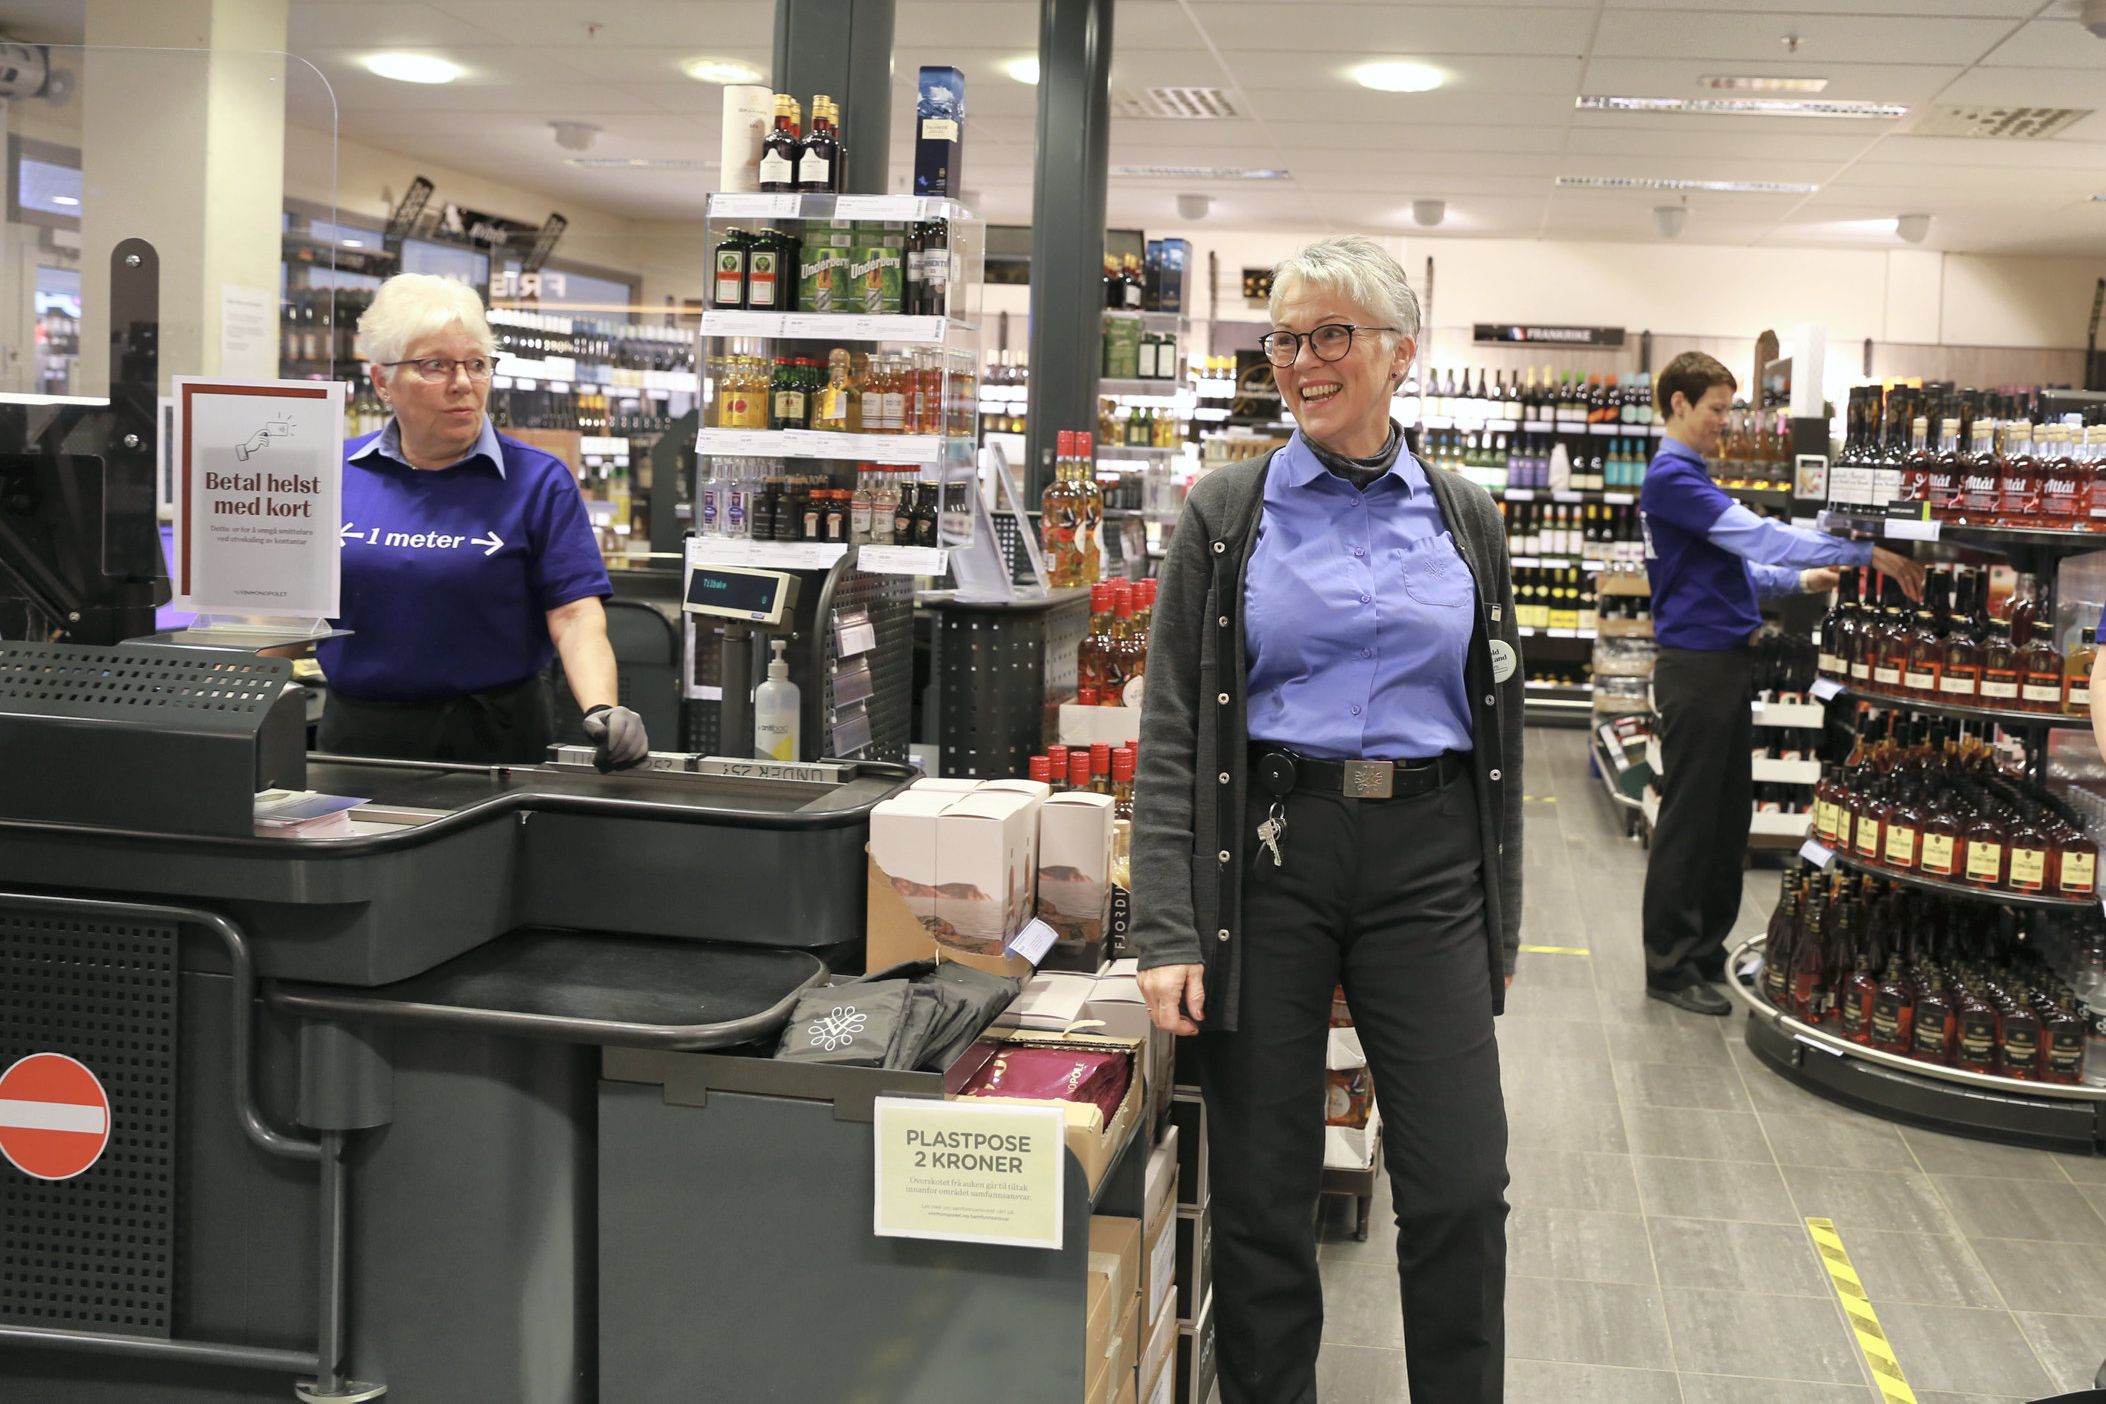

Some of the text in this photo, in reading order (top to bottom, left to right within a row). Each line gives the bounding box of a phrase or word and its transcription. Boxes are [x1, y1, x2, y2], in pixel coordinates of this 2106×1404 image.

[801, 257, 850, 279] Underberg
[851, 256, 901, 279] Underberg
[206, 472, 321, 494] Betal helst
[214, 497, 312, 517] med kort
[366, 527, 465, 548] 1 meter
[1114, 885, 1127, 949] FJORDI
[906, 1129, 1031, 1153] PLASTPOSE
[914, 1151, 1023, 1173] 2 KRONER
